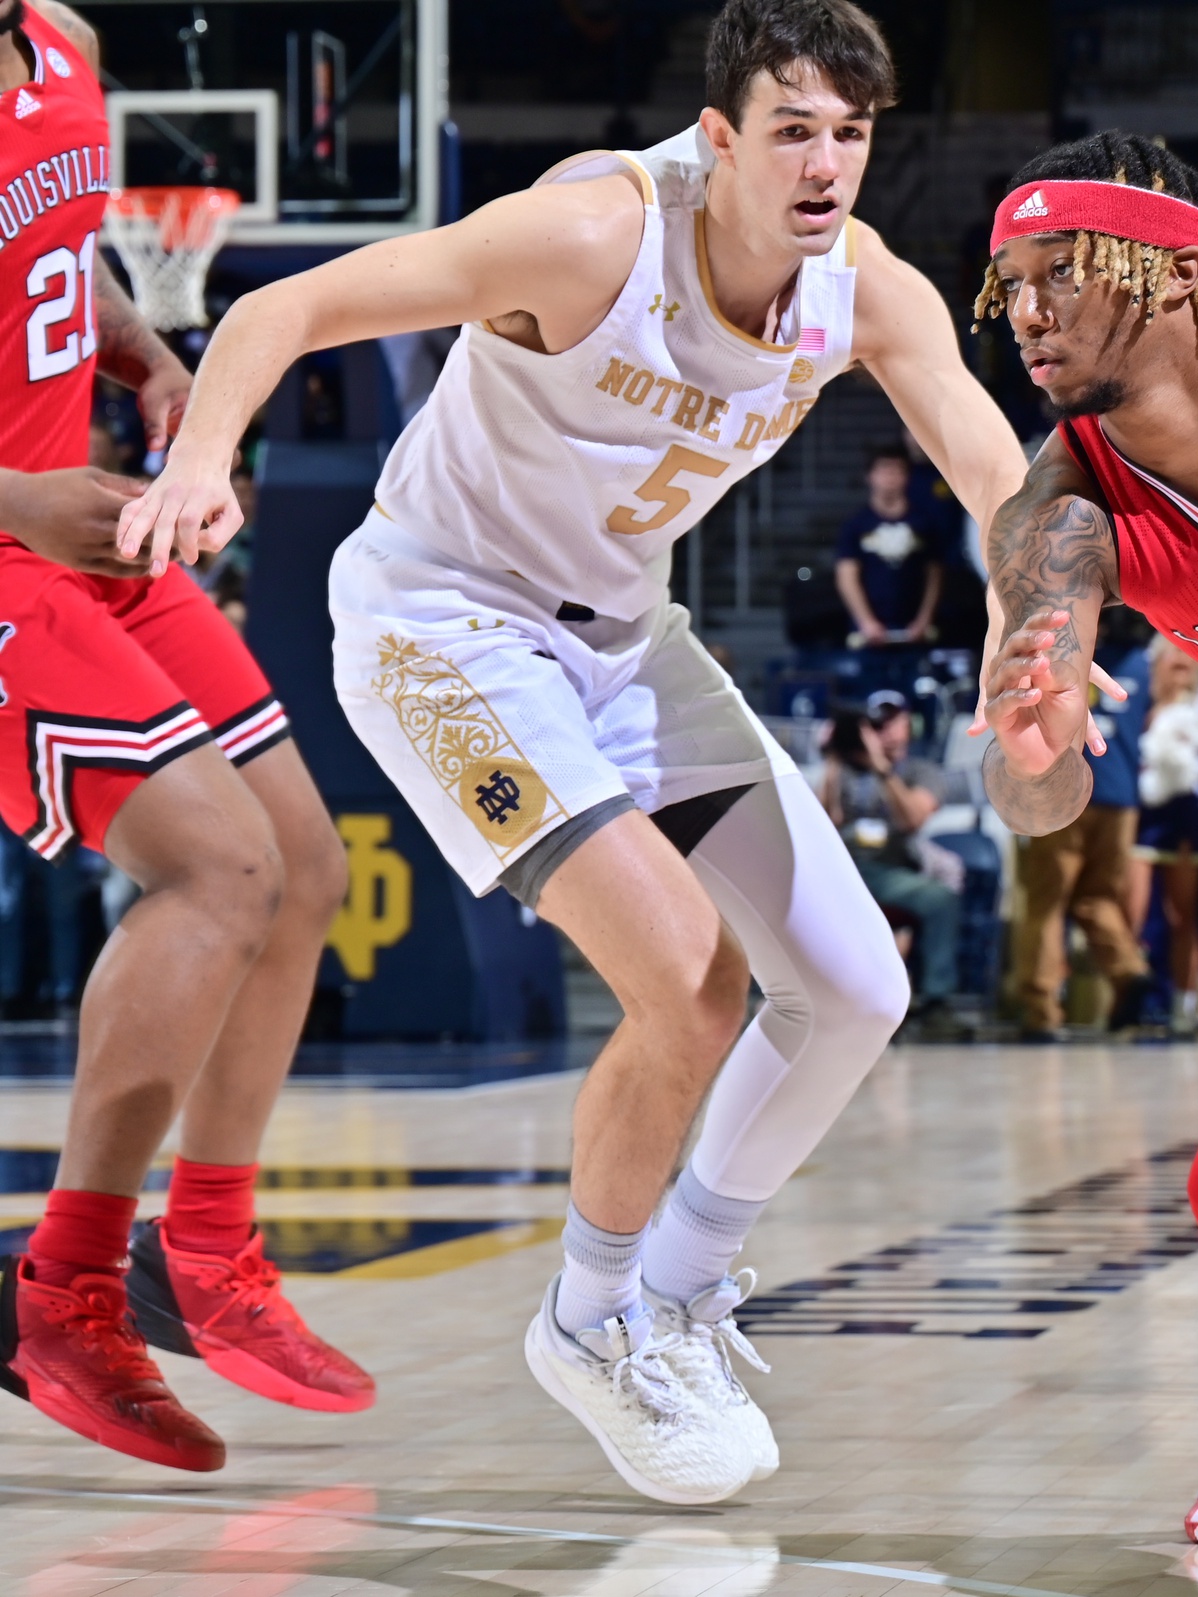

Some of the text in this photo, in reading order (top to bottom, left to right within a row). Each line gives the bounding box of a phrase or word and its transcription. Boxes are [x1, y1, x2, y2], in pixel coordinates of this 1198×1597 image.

[0, 145, 110, 249] OUISVILL
[1013, 206, 1048, 220] adidas
[26, 230, 97, 383] 21
[595, 357, 730, 442] NOTRE
[606, 443, 730, 535] 5
